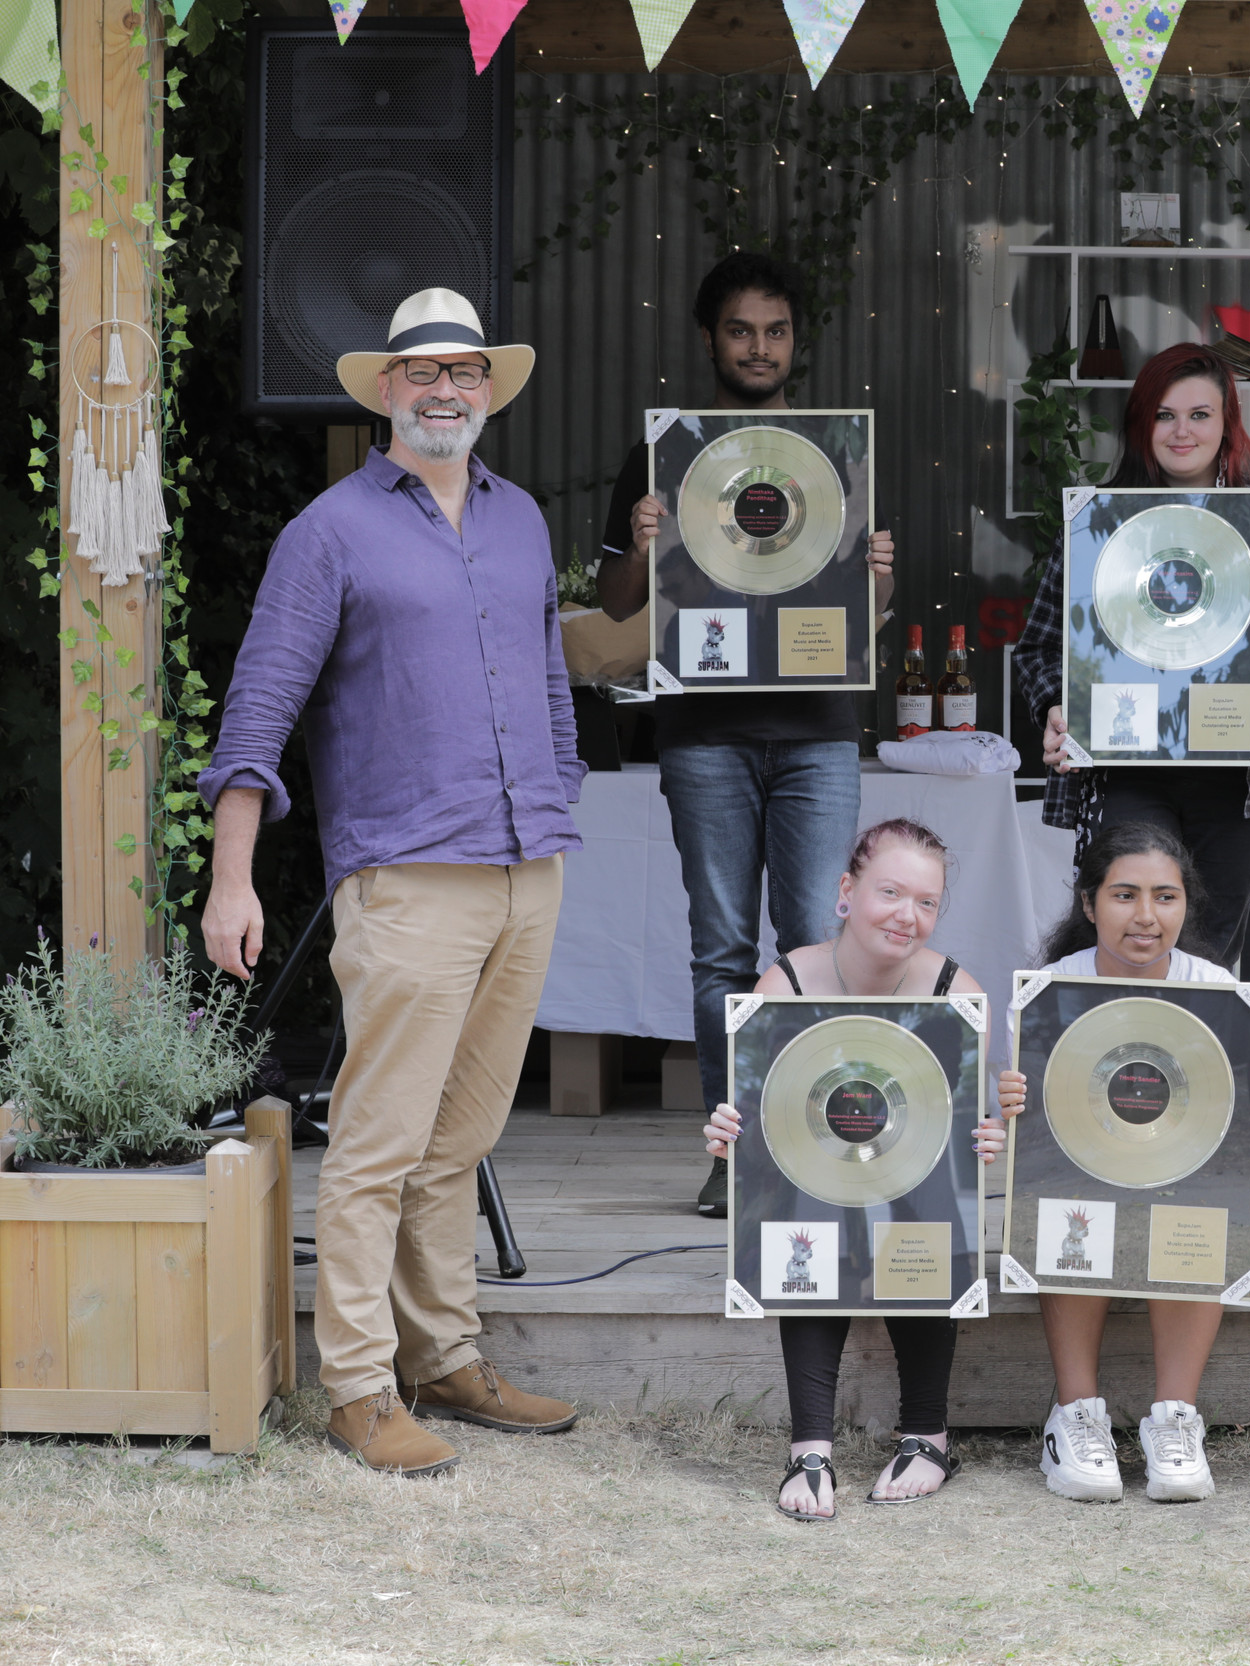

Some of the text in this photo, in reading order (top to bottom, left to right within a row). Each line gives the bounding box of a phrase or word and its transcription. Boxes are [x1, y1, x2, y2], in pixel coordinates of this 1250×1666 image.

[698, 661, 729, 671] SUPAJAM
[1109, 735, 1140, 746] SUPAJAM
[1018, 977, 1044, 1004] nielsen
[732, 1000, 758, 1028] nielsen
[955, 1000, 980, 1026] nielsen
[1056, 1258, 1092, 1271] SUPAJAM
[1164, 1250, 1195, 1258] Outstanding
[782, 1281, 817, 1293] SUPAJAM
[1006, 1261, 1032, 1288] nielsen
[732, 1285, 758, 1312] nielsen
[957, 1285, 982, 1313] nielsen
